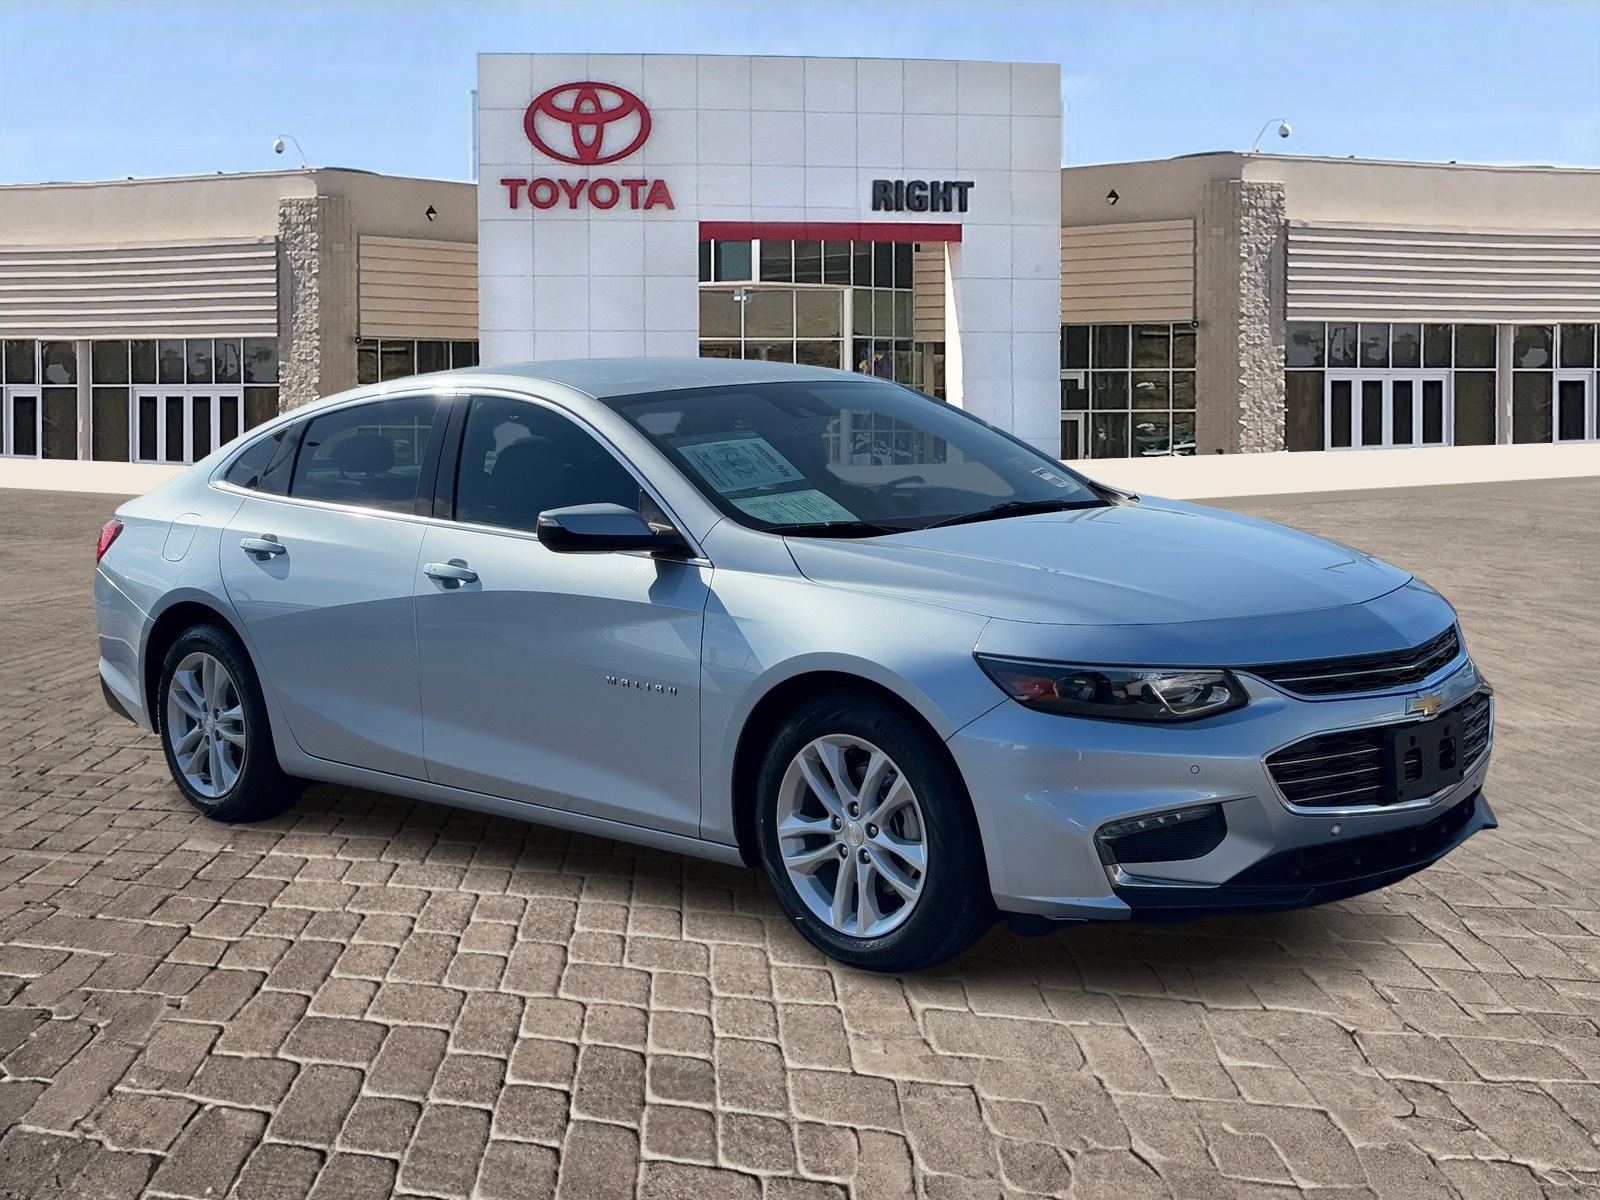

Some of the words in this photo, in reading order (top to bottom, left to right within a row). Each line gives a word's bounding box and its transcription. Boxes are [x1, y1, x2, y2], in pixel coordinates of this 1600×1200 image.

[501, 178, 675, 210] TOYOTA
[872, 179, 975, 212] RIGHT
[606, 675, 678, 696] MALIBU
